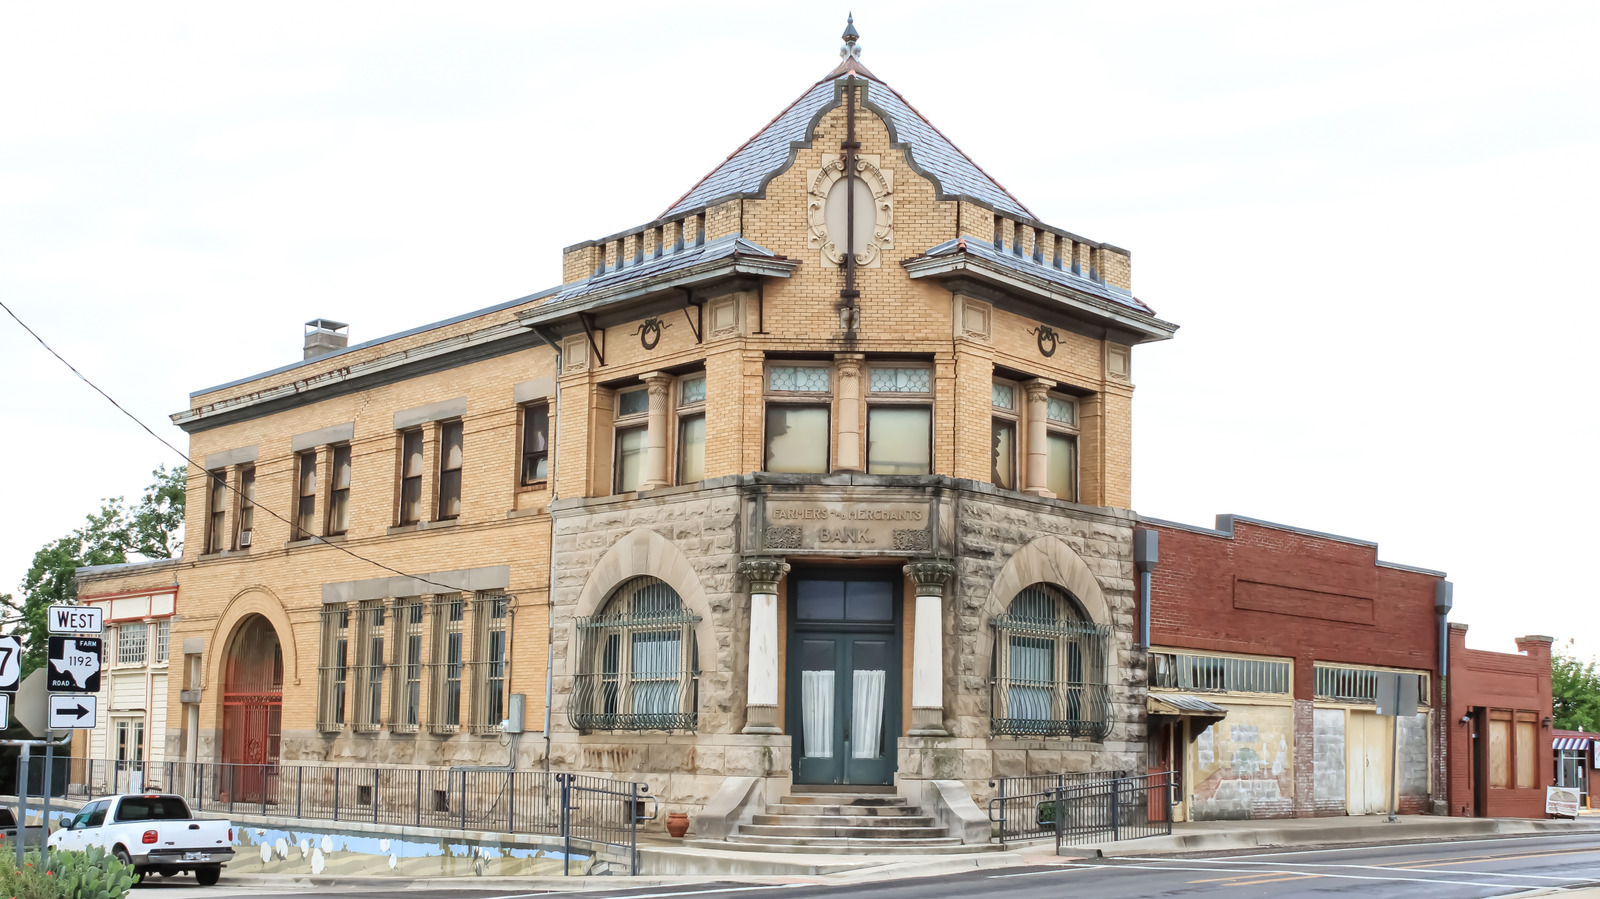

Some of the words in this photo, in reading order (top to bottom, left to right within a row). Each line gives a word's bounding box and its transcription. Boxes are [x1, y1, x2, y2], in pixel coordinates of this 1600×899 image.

[773, 508, 828, 520] FARMERS
[848, 509, 922, 521] MERCHANTS
[57, 610, 95, 629] WEST
[69, 656, 92, 667] 1192
